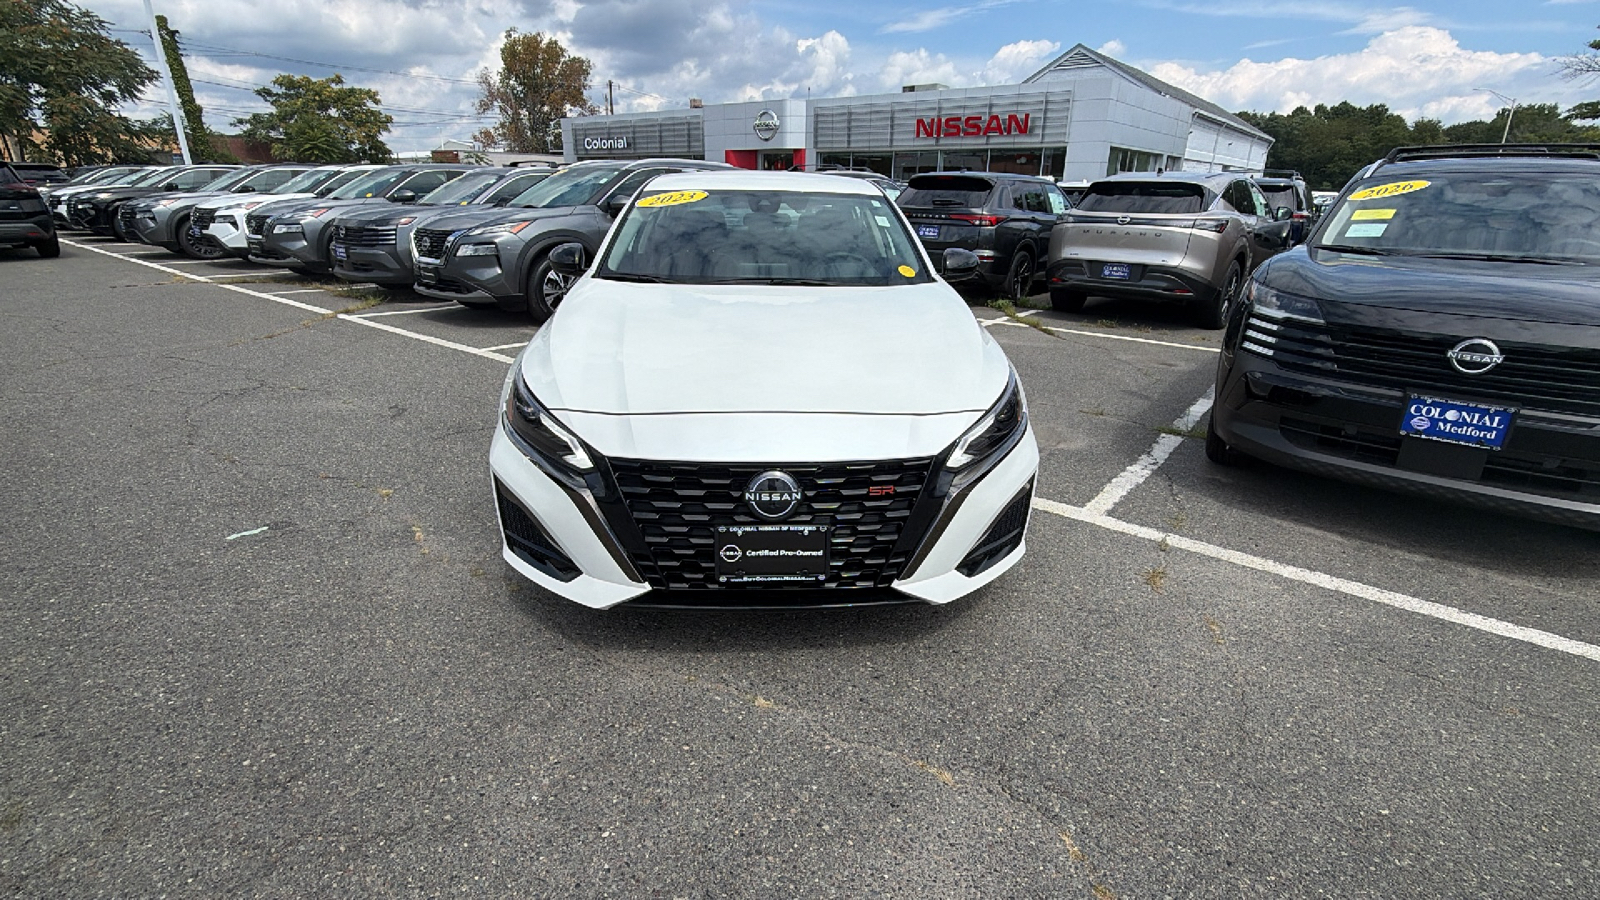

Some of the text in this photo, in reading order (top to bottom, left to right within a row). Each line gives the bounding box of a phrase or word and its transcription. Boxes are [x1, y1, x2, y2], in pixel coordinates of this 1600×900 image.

[915, 113, 1030, 138] NISSAN
[584, 137, 628, 150] Colonial
[1363, 183, 1414, 198] 2026
[650, 192, 697, 206] 2023
[1447, 350, 1504, 363] NISSAN
[1410, 404, 1504, 429] COLONIAL
[1436, 421, 1497, 440] Medford
[745, 492, 801, 501] NISSAN
[869, 485, 894, 496] SR
